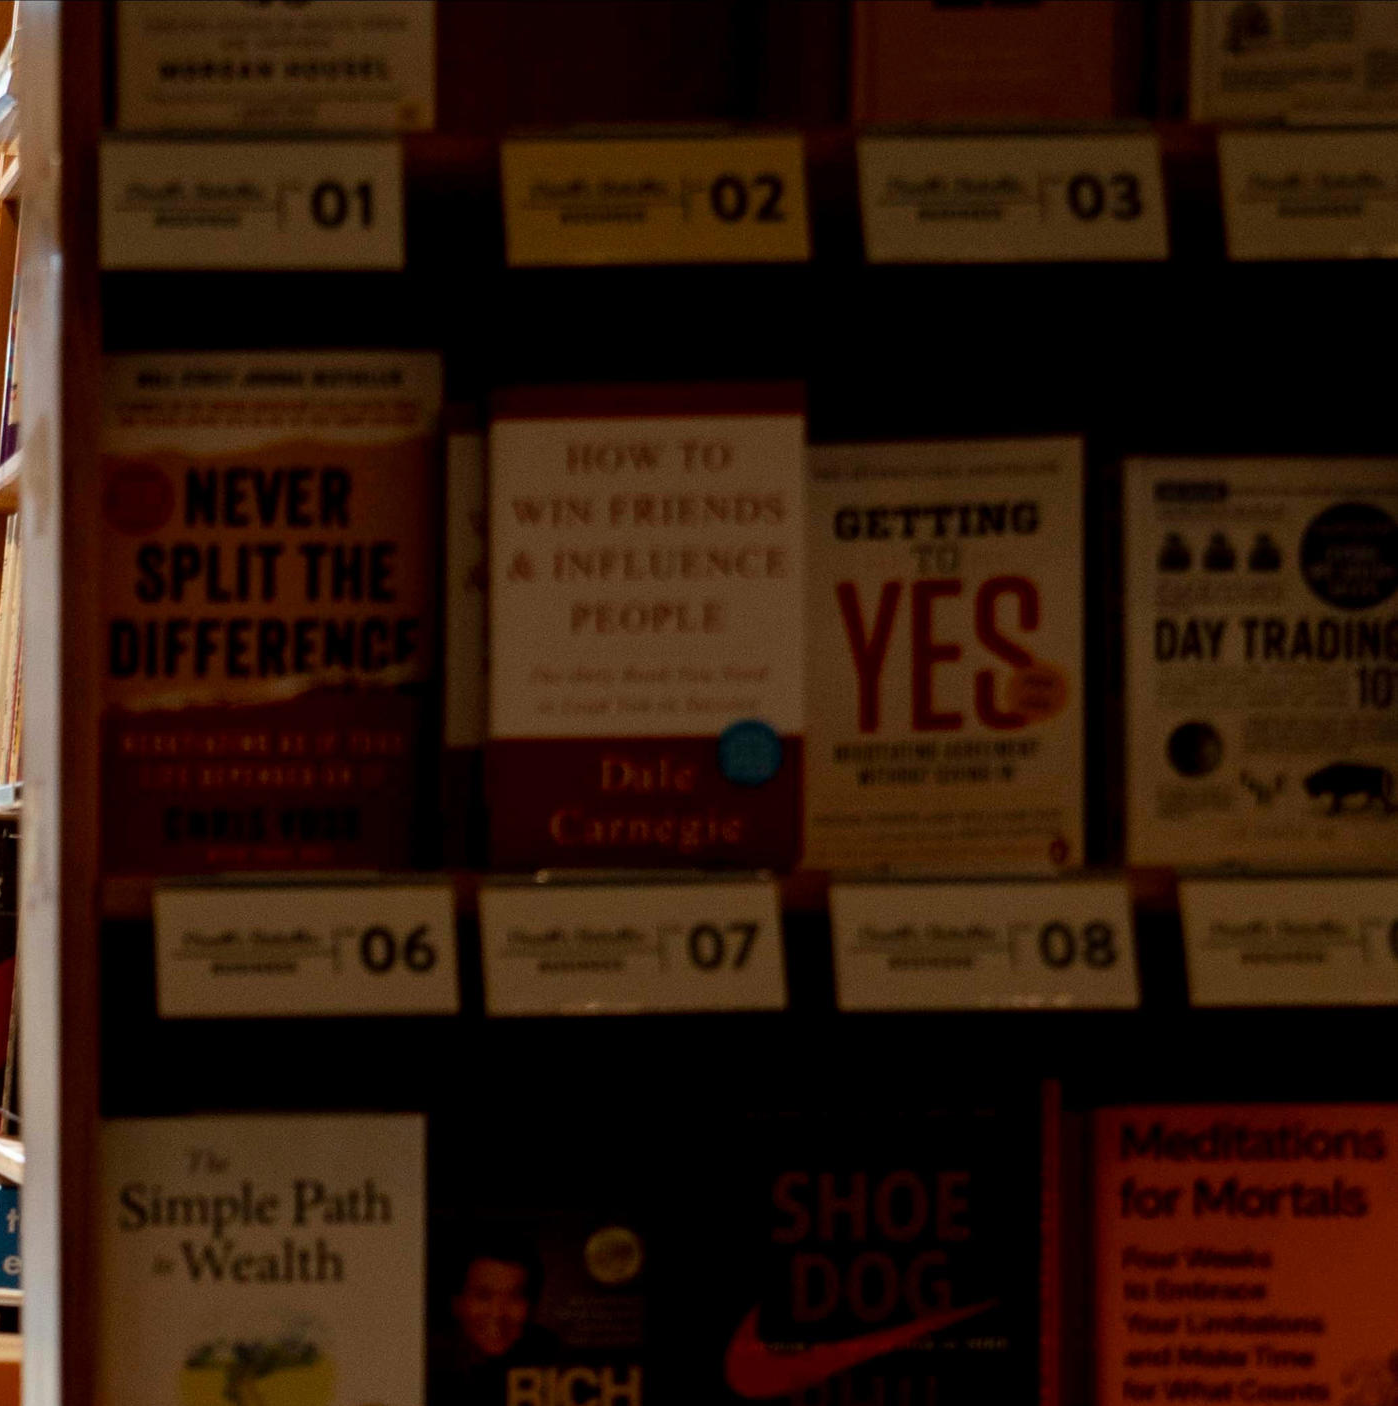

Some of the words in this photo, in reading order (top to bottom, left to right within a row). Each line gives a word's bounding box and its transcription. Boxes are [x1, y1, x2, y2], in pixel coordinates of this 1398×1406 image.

[311, 181, 372, 229] 01
[711, 172, 784, 222] 02
[1067, 173, 1142, 220] 03
[565, 442, 659, 474] HOW
[682, 441, 733, 472] TO
[185, 467, 351, 528] NEVER
[510, 495, 593, 526] WIN
[608, 493, 787, 525] FRIENDS
[835, 501, 1040, 541] GETTING
[135, 542, 284, 603] SPLIT
[300, 542, 397, 602] THE
[552, 547, 788, 580] INFLUENCE
[570, 601, 725, 634] PEOPLE
[1154, 618, 1225, 662] DAY
[109, 618, 420, 678] DIFFERENCE
[836, 576, 1040, 733] YES
[600, 758, 694, 791] Dale
[549, 810, 745, 854] Carnegie
[359, 925, 438, 974] 06
[687, 922, 759, 972] 07
[1038, 920, 1117, 970] 08
[1118, 1121, 1386, 1163] Meditations
[119, 1178, 281, 1239] Simple
[292, 1176, 394, 1226] Path
[770, 1167, 974, 1245] SHOE
[1121, 1176, 1181, 1218] for
[1194, 1177, 1369, 1218] Mortals
[181, 1238, 345, 1284] Wealth
[788, 1248, 957, 1324] DOG
